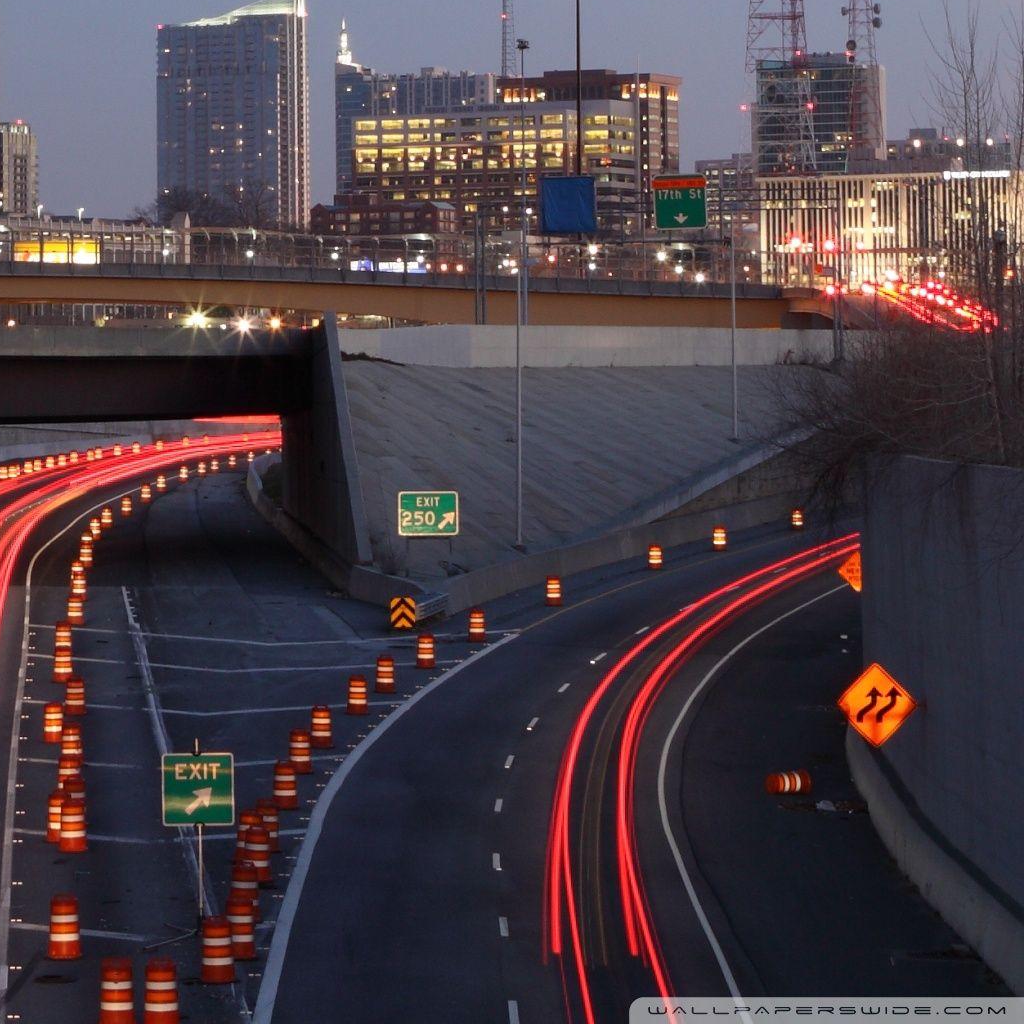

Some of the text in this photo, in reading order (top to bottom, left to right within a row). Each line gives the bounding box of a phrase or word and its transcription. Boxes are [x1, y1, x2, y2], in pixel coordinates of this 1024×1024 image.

[658, 188, 702, 200] 17th St
[416, 497, 440, 507] EXIT
[401, 511, 436, 526] 250
[175, 763, 221, 780] EXIT
